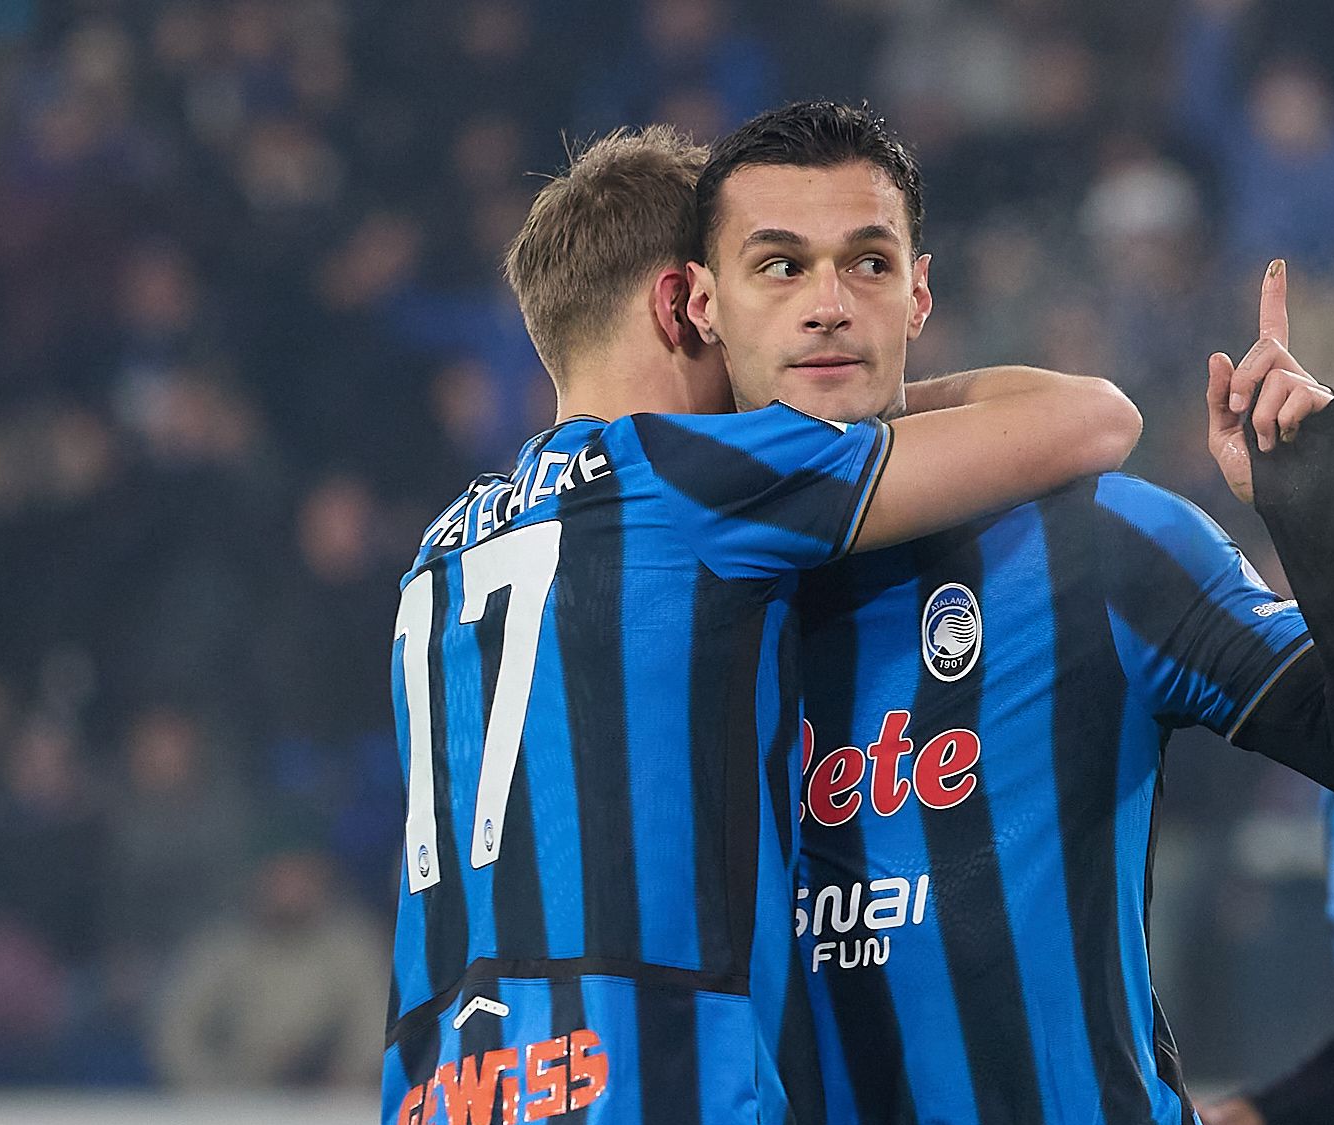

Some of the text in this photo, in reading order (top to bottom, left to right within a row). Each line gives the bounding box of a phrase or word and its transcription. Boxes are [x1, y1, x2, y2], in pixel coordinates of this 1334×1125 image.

[930, 597, 971, 613] ATALANTA
[939, 657, 964, 669] 1907
[393, 521, 562, 895] 17
[802, 710, 981, 827] ete
[812, 936, 890, 973] FUN
